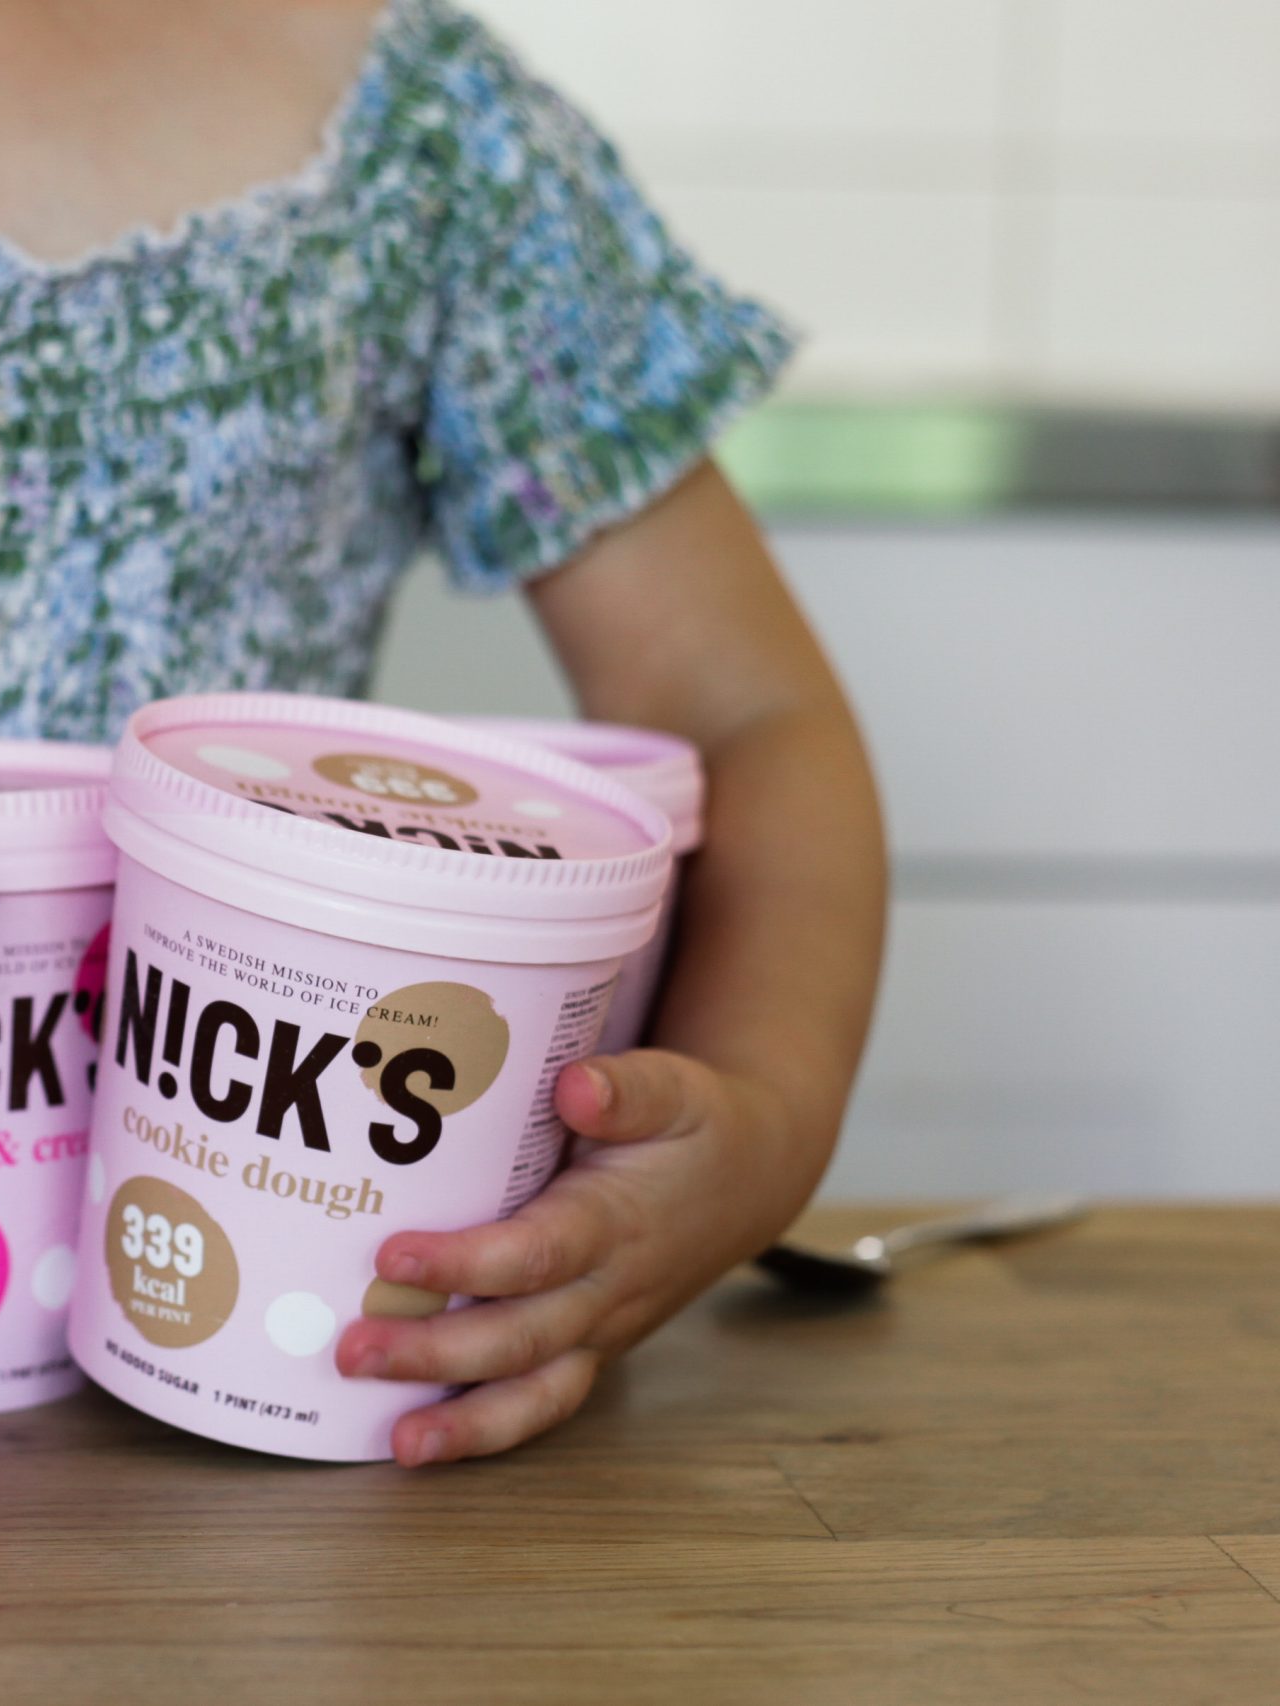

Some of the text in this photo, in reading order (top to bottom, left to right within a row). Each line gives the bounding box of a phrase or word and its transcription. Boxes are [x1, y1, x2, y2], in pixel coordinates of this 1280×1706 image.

[144, 923, 439, 1028] IMPROVE THE WORLD OF ICE CREAM!
[182, 929, 378, 1000] A SWEDISH MISSION TO
[123, 1105, 385, 1221] cookie dough
[121, 1203, 204, 1278] 339
[132, 1264, 186, 1306] kcal
[120, 1349, 155, 1377] ADDED
[158, 1368, 200, 1395] SUGAR
[213, 1389, 220, 1403] 1
[224, 1393, 258, 1412] PINT
[259, 1402, 291, 1419] (473
